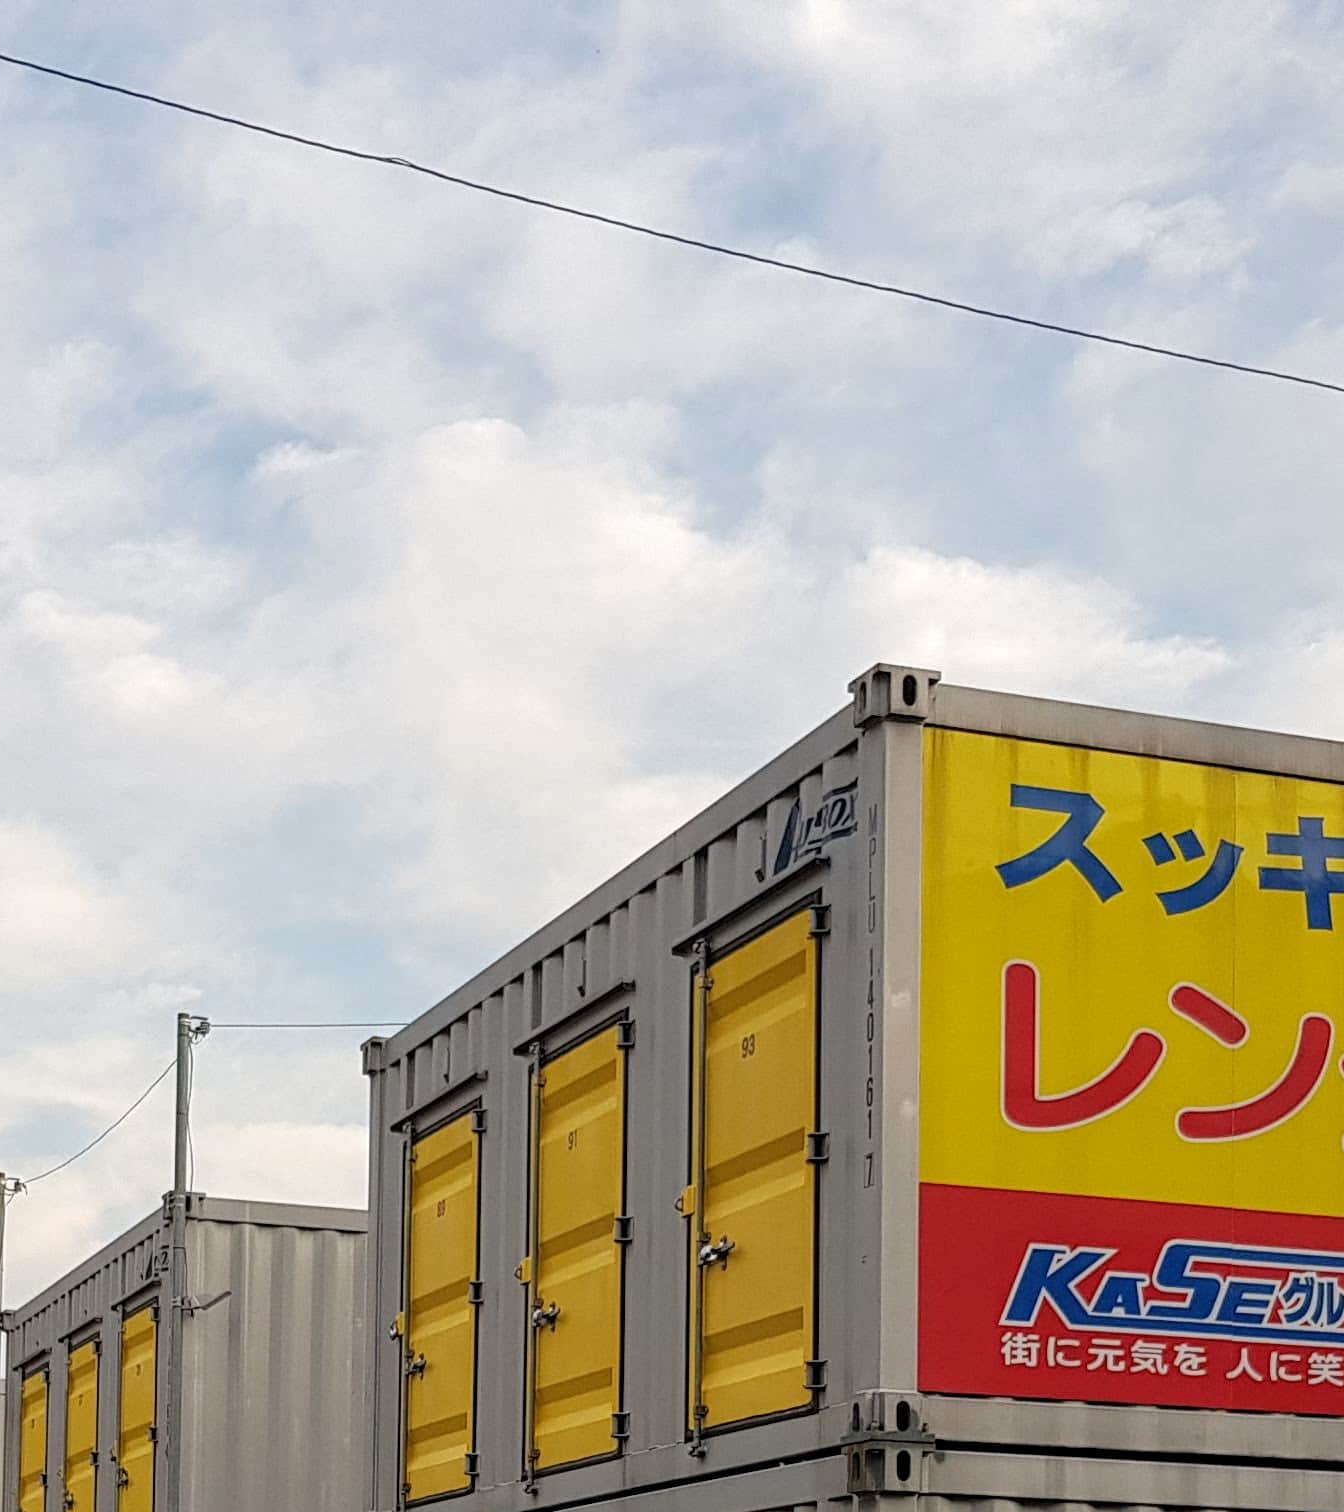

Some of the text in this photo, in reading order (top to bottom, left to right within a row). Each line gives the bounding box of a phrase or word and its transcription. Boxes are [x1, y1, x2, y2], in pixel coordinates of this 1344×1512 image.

[868, 804, 878, 933] MPLU
[741, 1033, 756, 1059] 93
[866, 948, 875, 1140] 140161
[568, 1129, 578, 1150] 91
[1001, 1332, 1207, 1376] 街に元気を
